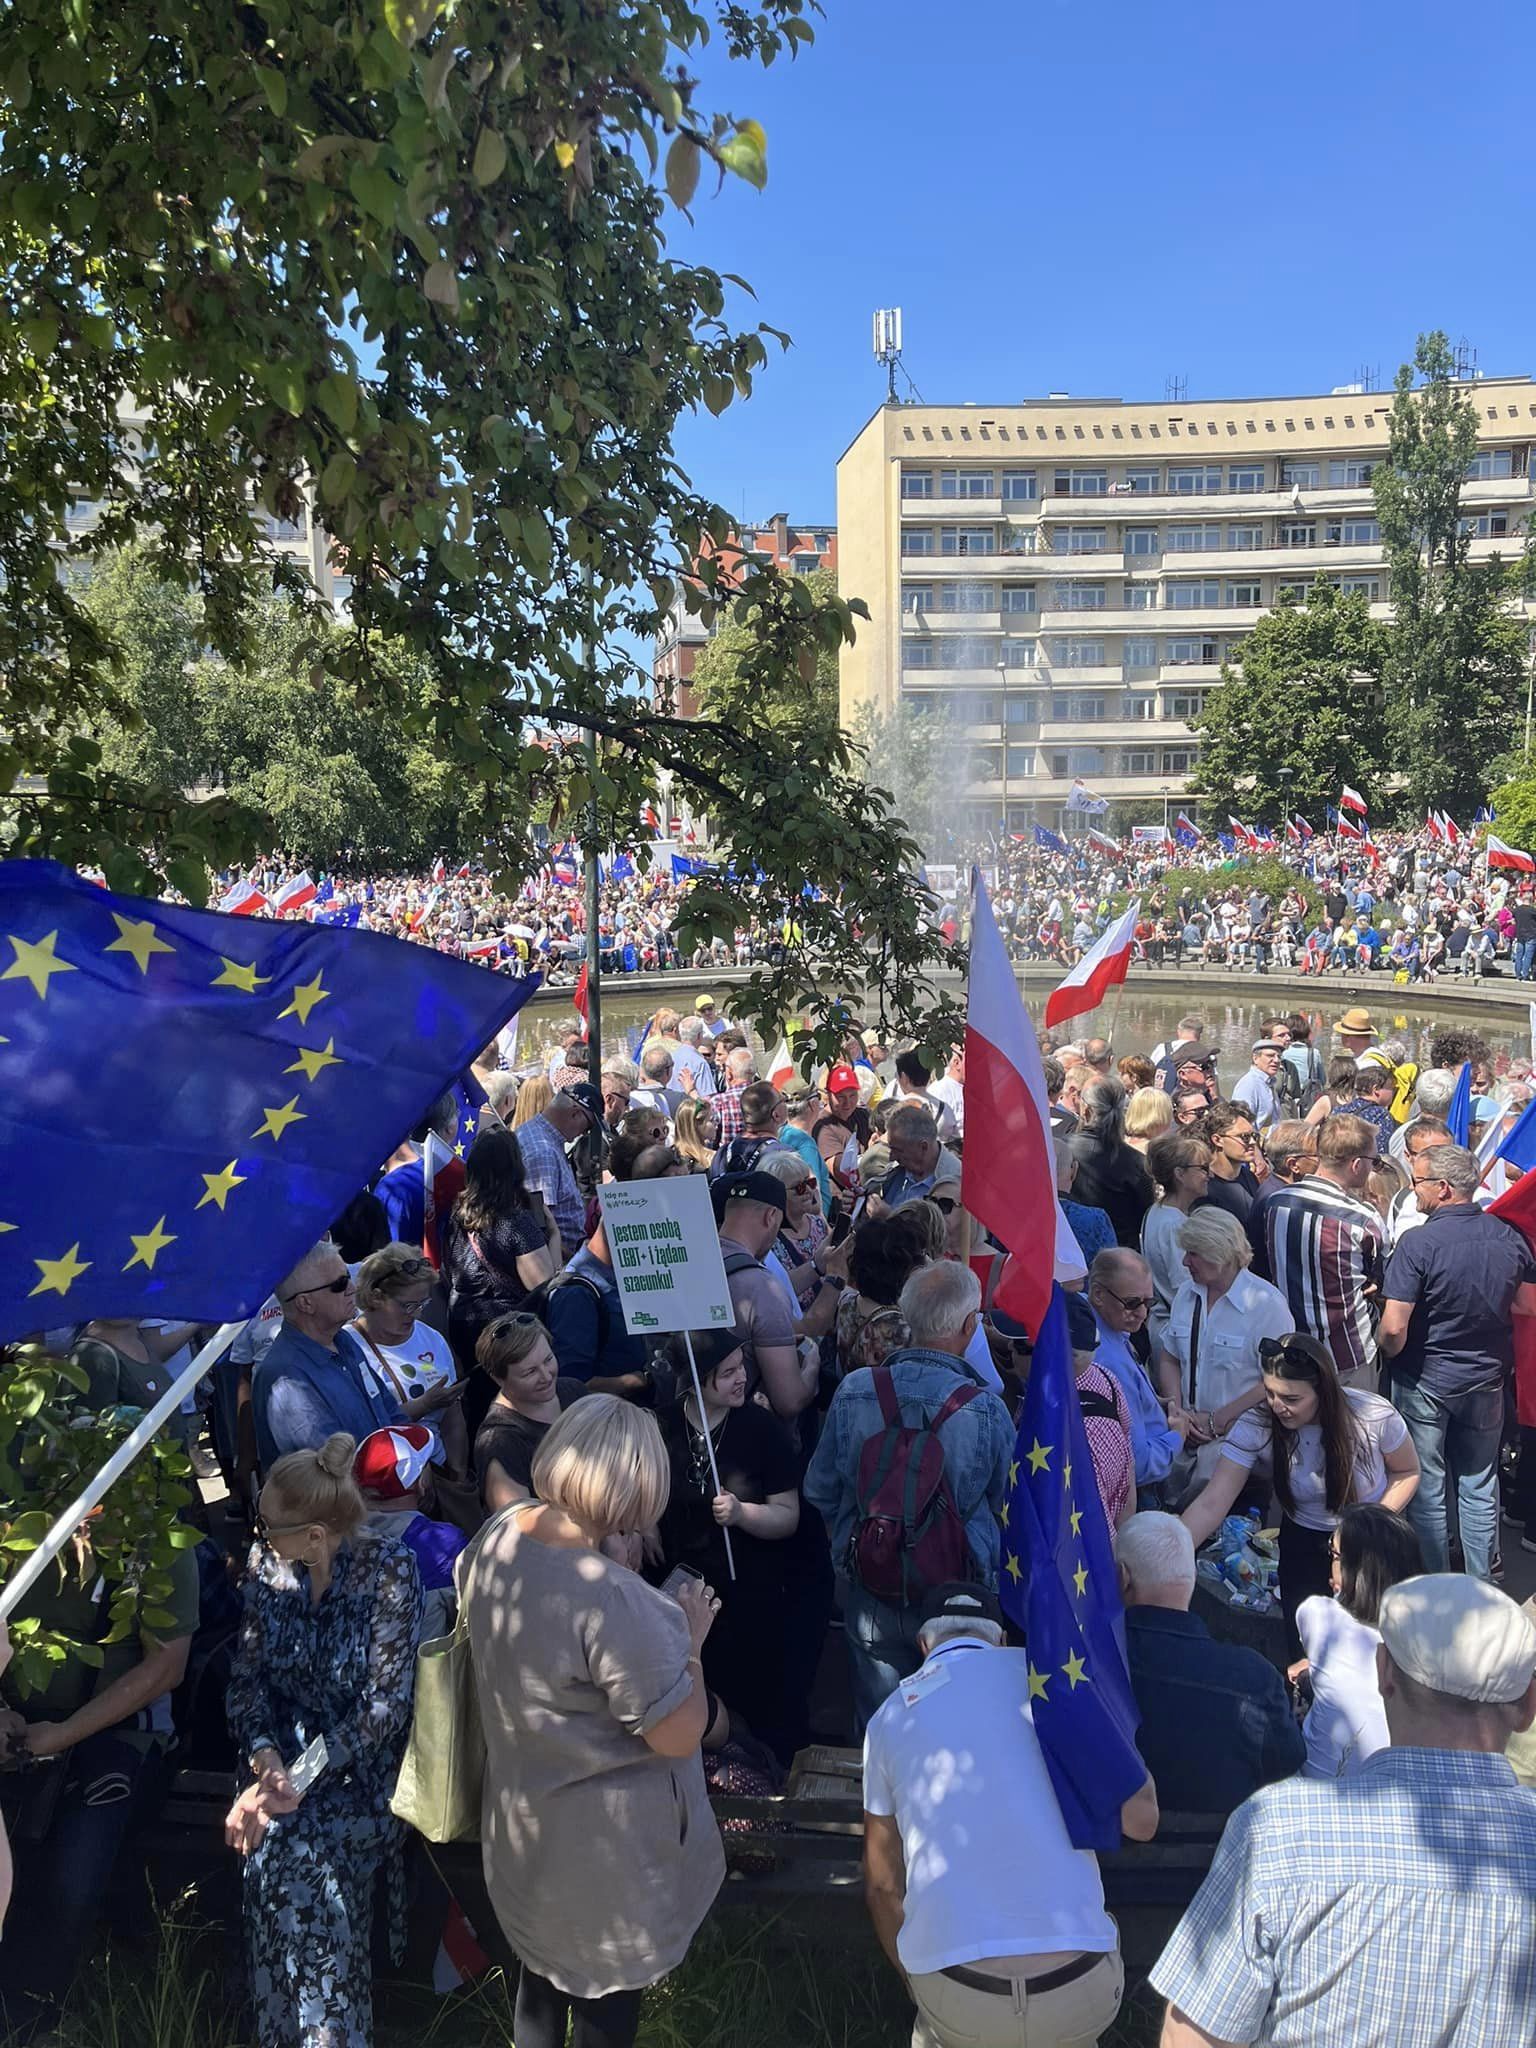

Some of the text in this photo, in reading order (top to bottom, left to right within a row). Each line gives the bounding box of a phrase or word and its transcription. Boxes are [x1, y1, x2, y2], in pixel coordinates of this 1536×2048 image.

[611, 1217, 682, 1246] jestem osobą
[617, 1243, 688, 1268] LGBT+ i żądam
[623, 1269, 674, 1293] szacunku!
